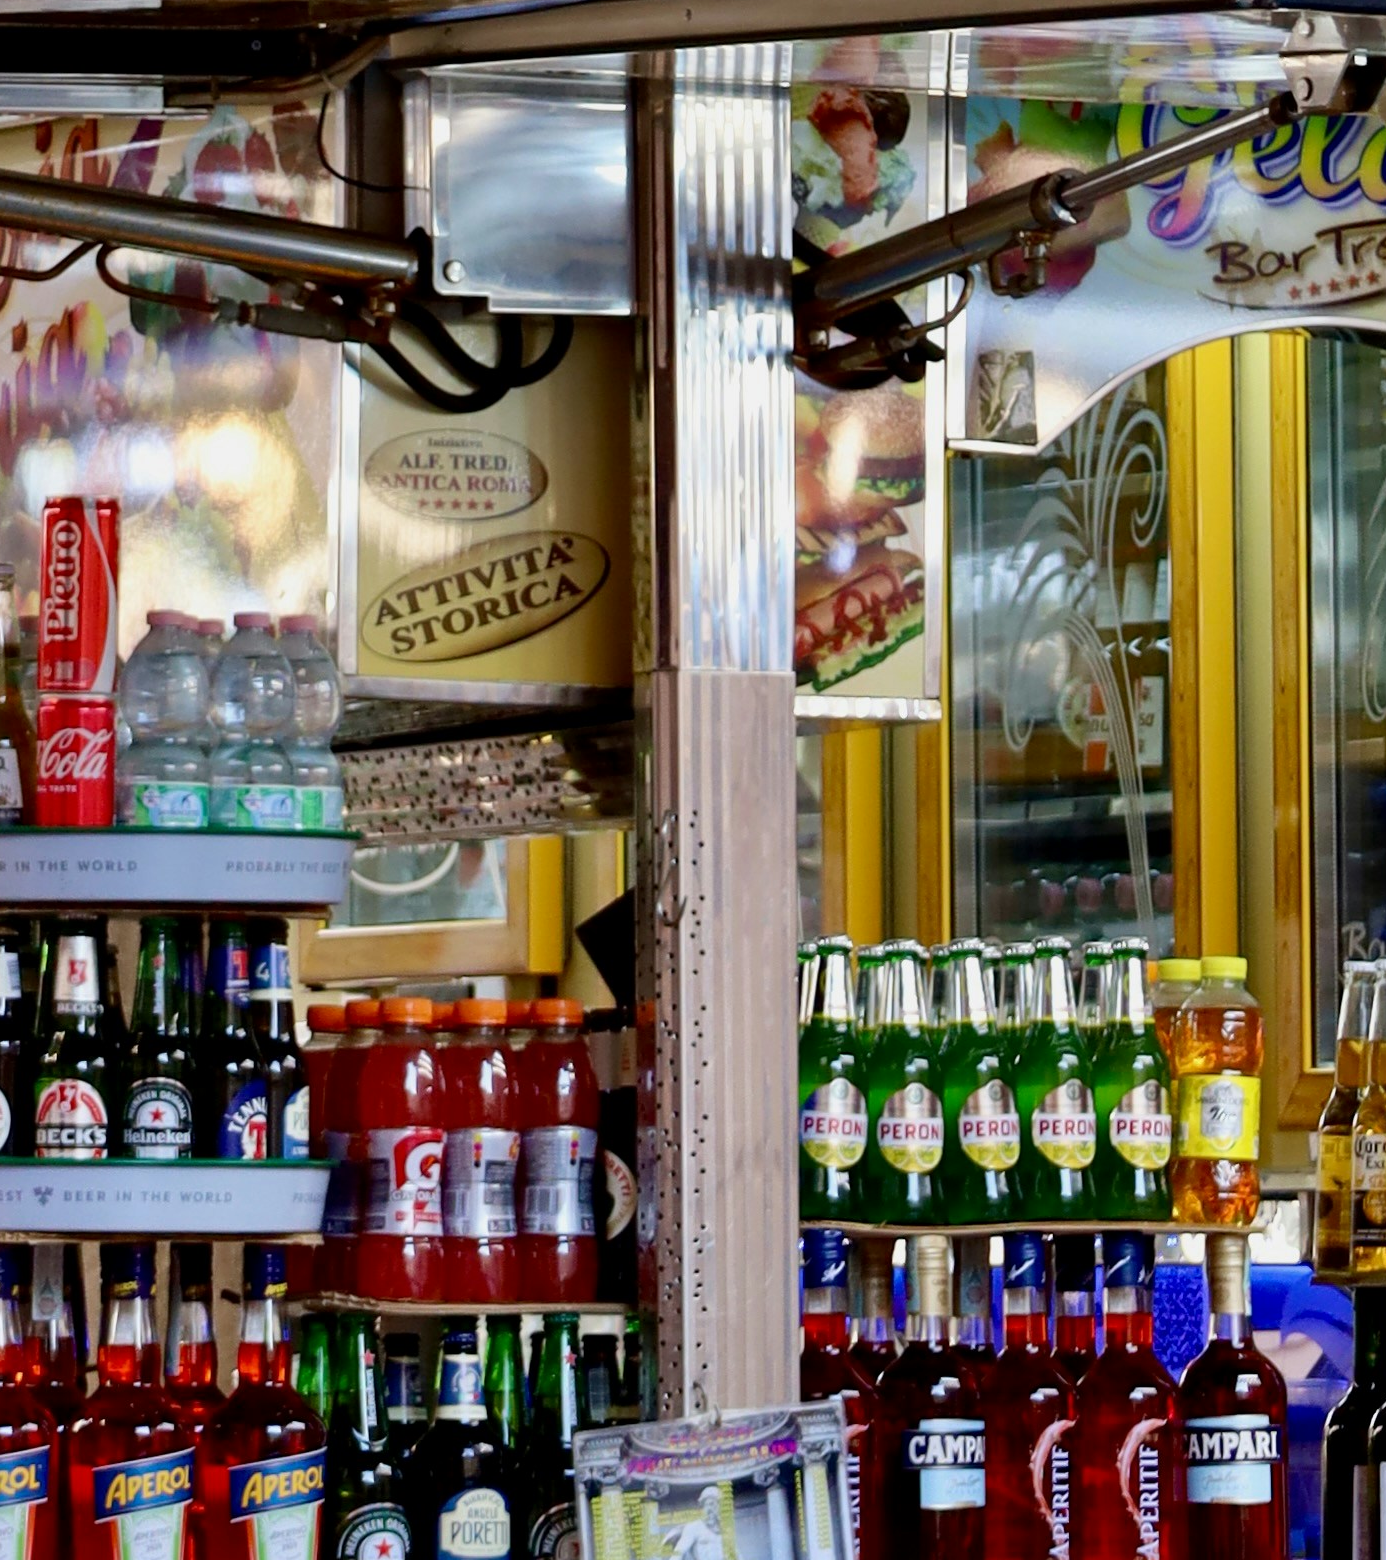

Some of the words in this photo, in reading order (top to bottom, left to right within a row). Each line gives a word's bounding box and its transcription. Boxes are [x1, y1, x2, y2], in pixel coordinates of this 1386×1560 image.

[1206, 241, 1317, 284] Bar
[380, 474, 461, 493] ANTICA
[467, 475, 534, 495] ROMA
[43, 519, 83, 646] Pietro
[374, 536, 576, 627] ATTIVITA'
[390, 572, 584, 655] STORICA
[15, 860, 30, 873] IN
[39, 859, 69, 873] THE
[77, 859, 139, 873] WORLD
[225, 860, 296, 874] PROBABLY
[35, 1124, 107, 1145] BECK'S
[123, 1129, 192, 1145] Heineken
[63, 1189, 107, 1203] BEER
[115, 1189, 133, 1203] IN
[140, 1190, 172, 1203] THE
[179, 1190, 233, 1203] WORLD
[908, 1433, 986, 1466] CAMPA
[1186, 1430, 1281, 1461] AMPARI
[104, 1464, 192, 1508] APEROL
[1049, 1445, 1071, 1560] APERITIF
[1137, 1444, 1161, 1560] APERITIF
